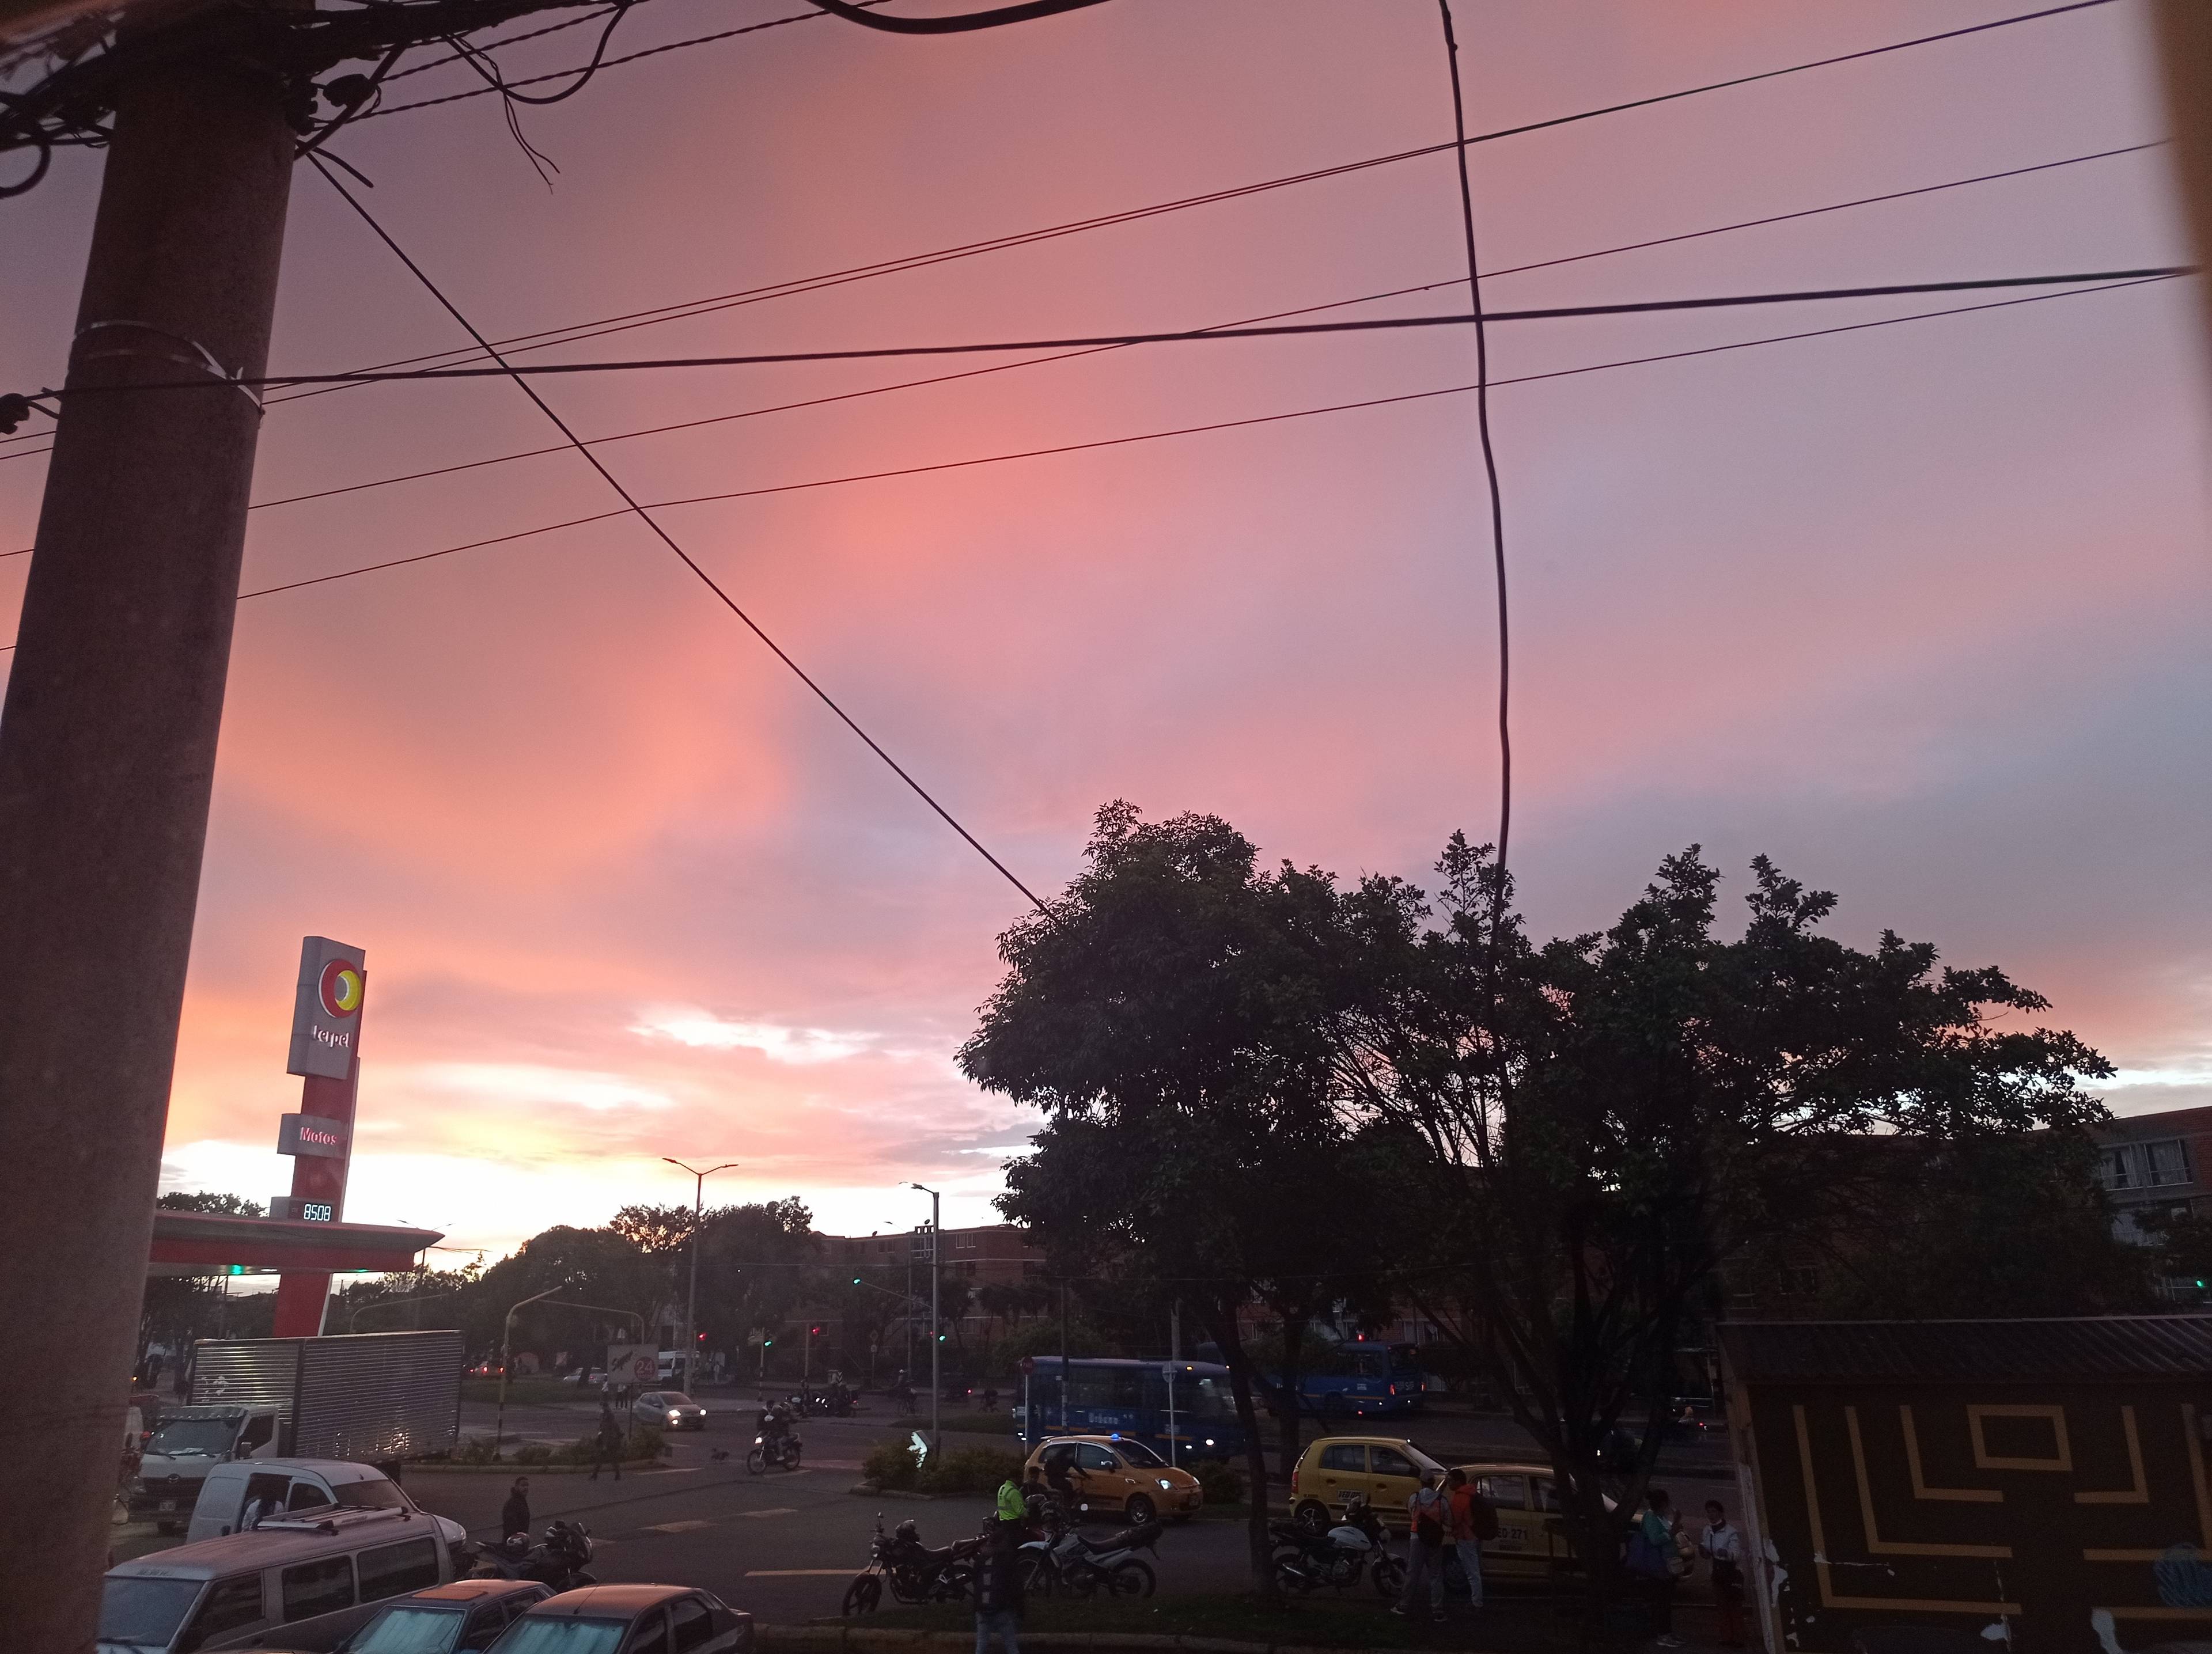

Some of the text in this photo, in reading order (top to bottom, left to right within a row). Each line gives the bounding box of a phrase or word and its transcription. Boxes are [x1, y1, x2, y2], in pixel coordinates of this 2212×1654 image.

[299, 1126, 337, 1145] Motos
[303, 1204, 331, 1221] 8508
[636, 1360, 654, 1374] 24
